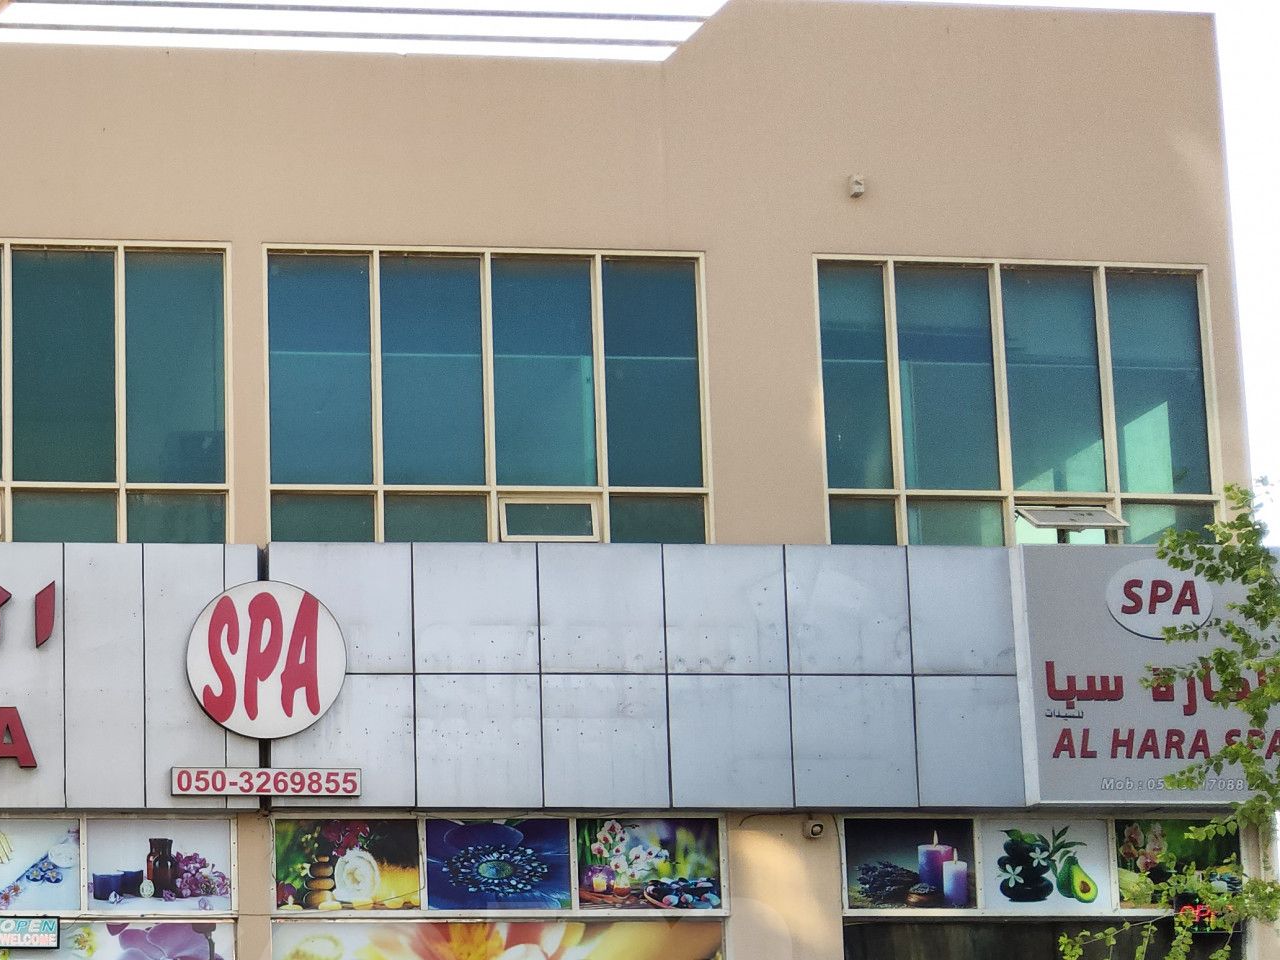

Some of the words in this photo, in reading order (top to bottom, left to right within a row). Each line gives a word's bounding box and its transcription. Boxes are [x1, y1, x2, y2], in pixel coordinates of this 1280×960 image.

[1121, 579, 1200, 615] SPA
[202, 590, 321, 723] SPA
[1052, 727, 1098, 759] AL
[1110, 728, 1212, 760] HARA
[177, 769, 358, 794] 050-3269855
[0, 919, 56, 933] OPEN
[0, 933, 57, 946] WELCOME
